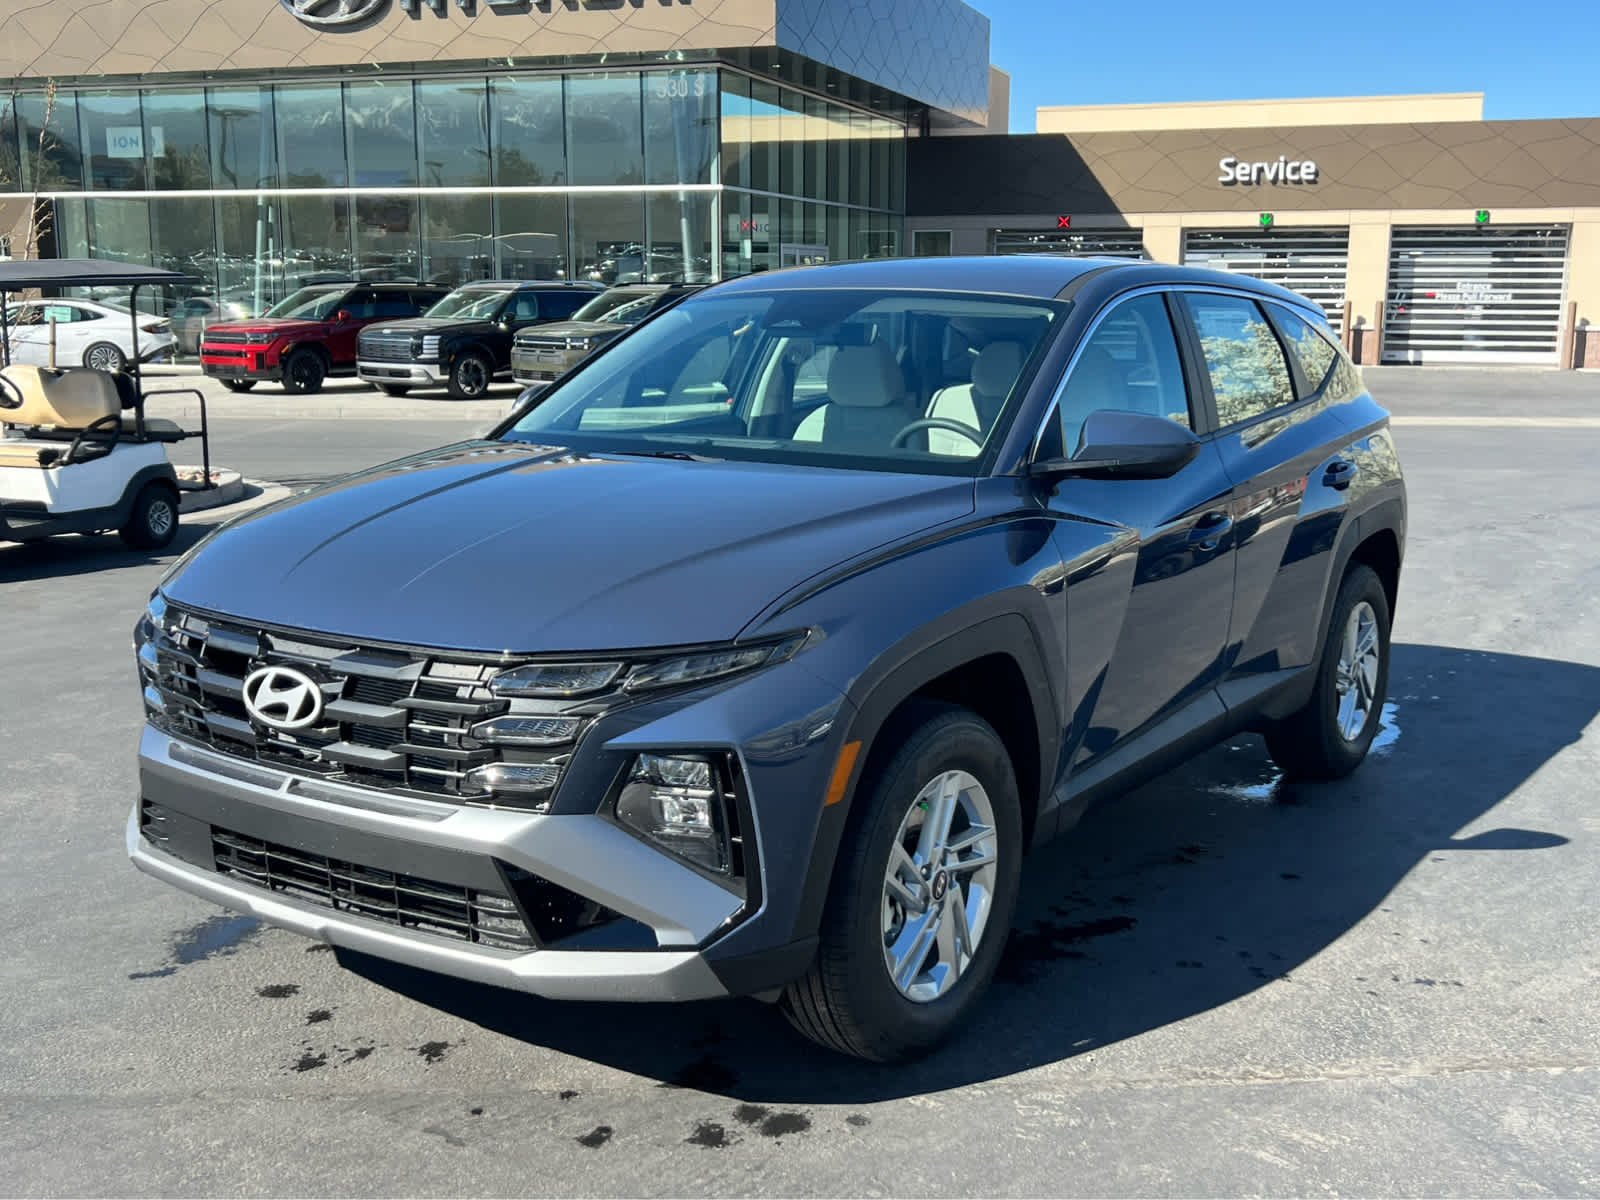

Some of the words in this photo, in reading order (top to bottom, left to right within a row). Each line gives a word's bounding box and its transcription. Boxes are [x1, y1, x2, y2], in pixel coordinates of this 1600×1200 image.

[694, 79, 705, 97] S
[1218, 155, 1317, 182] Service
[1456, 281, 1493, 291] Entrance
[1435, 292, 1460, 301] Please
[1463, 292, 1478, 301] Pull
[1479, 292, 1513, 301] Forward
